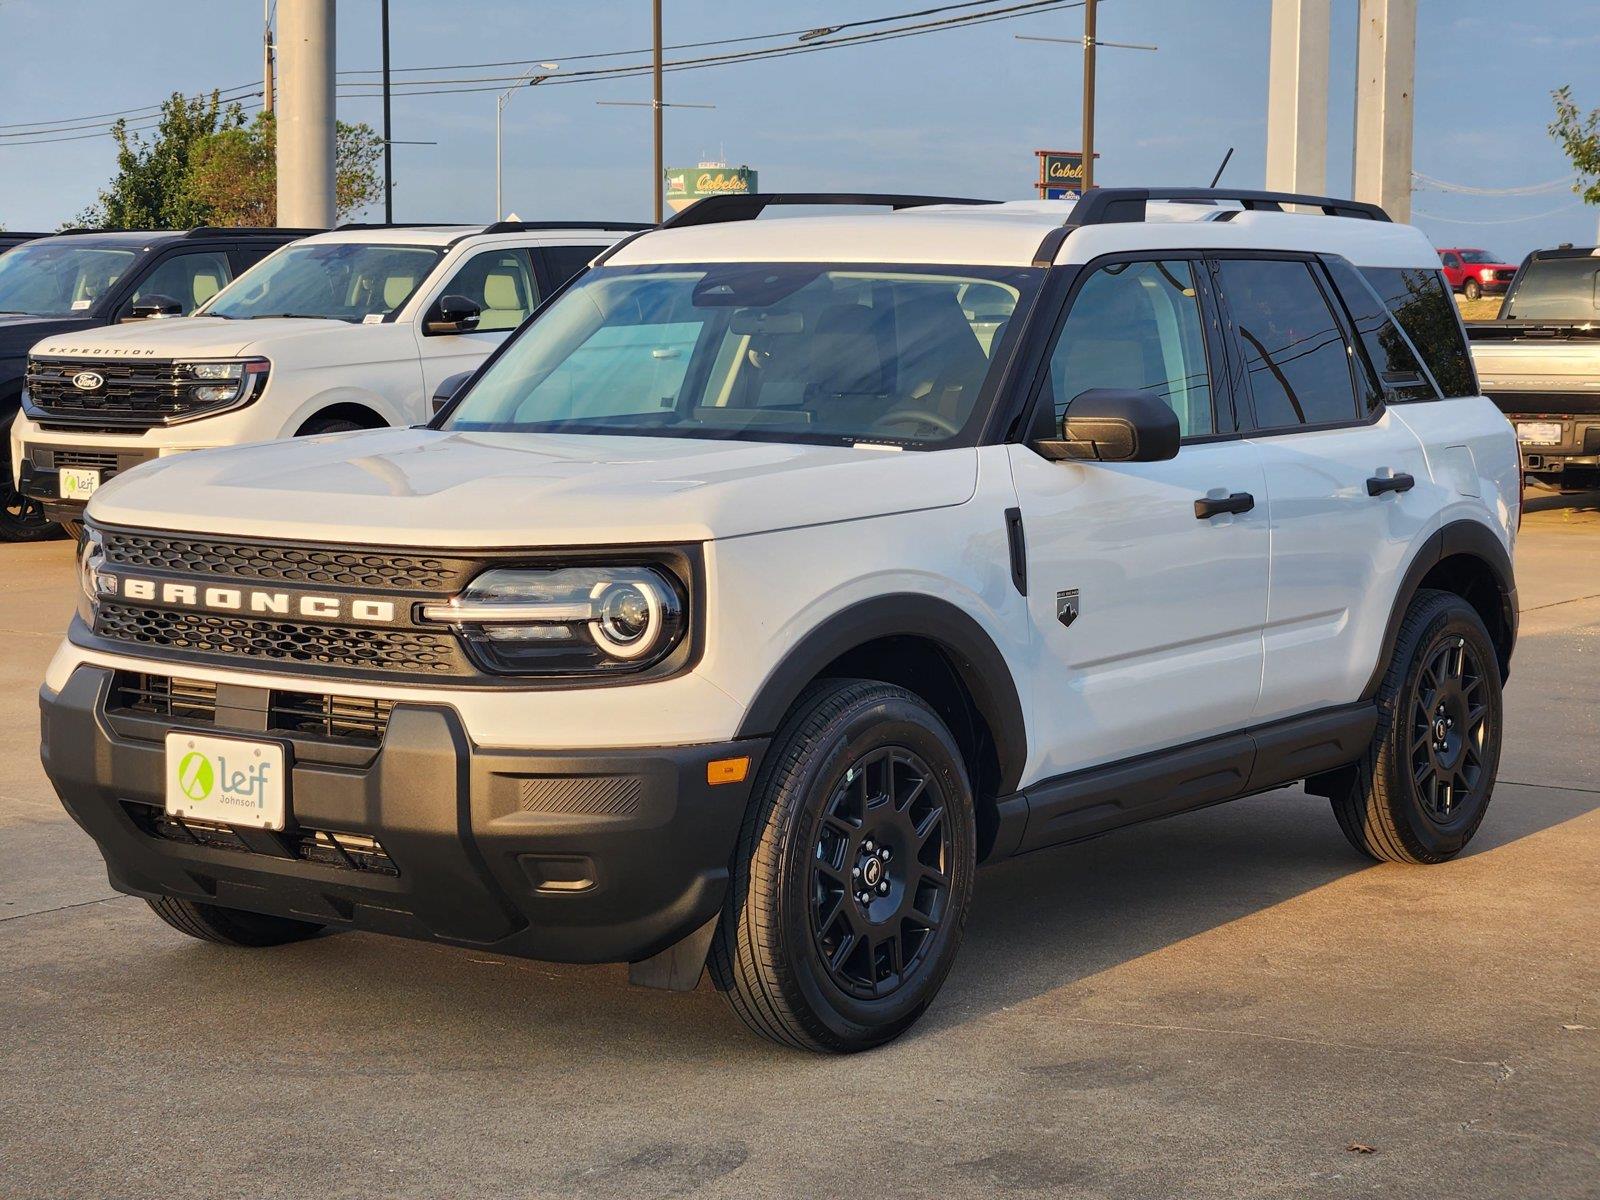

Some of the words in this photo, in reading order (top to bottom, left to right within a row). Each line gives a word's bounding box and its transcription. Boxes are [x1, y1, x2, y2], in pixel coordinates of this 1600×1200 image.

[1050, 162, 1083, 178] Cabel
[48, 347, 155, 355] EXPEDITION
[77, 374, 98, 387] Ford
[124, 579, 395, 621] BRONCO
[218, 756, 271, 808] leif
[219, 795, 256, 808] Johnson
